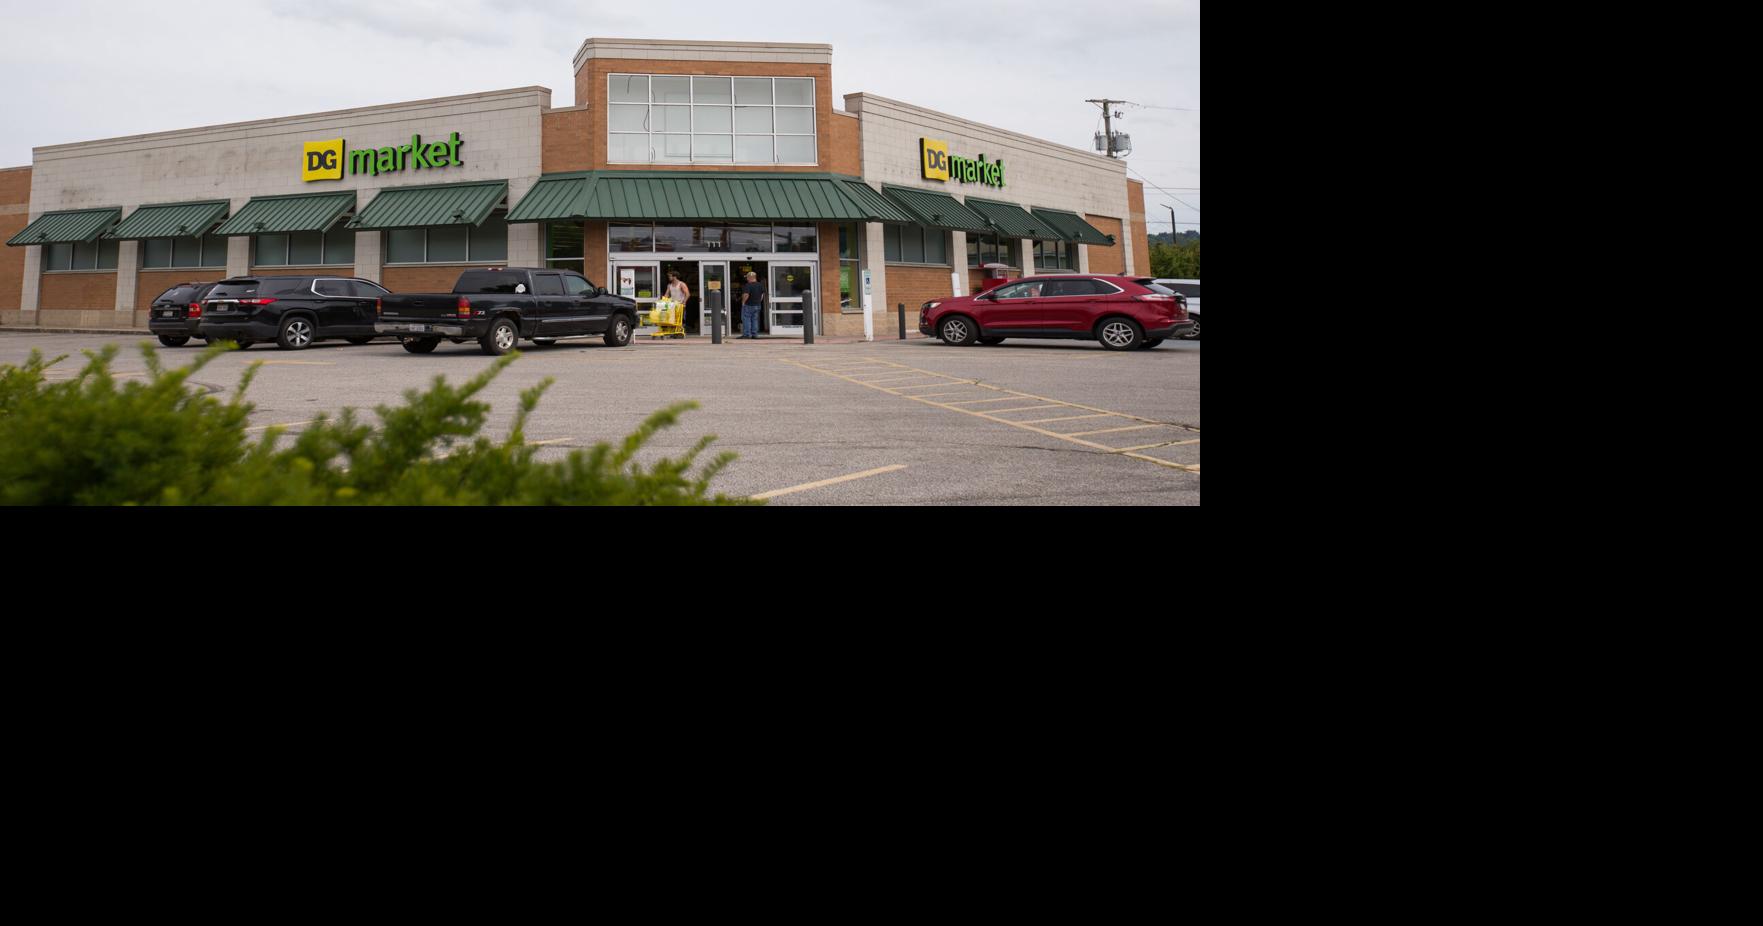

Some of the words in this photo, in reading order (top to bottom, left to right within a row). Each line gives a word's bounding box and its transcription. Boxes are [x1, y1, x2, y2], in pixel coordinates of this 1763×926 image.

[307, 150, 337, 171] DG
[350, 131, 463, 176] market
[927, 148, 946, 171] DG
[950, 153, 1006, 187] market
